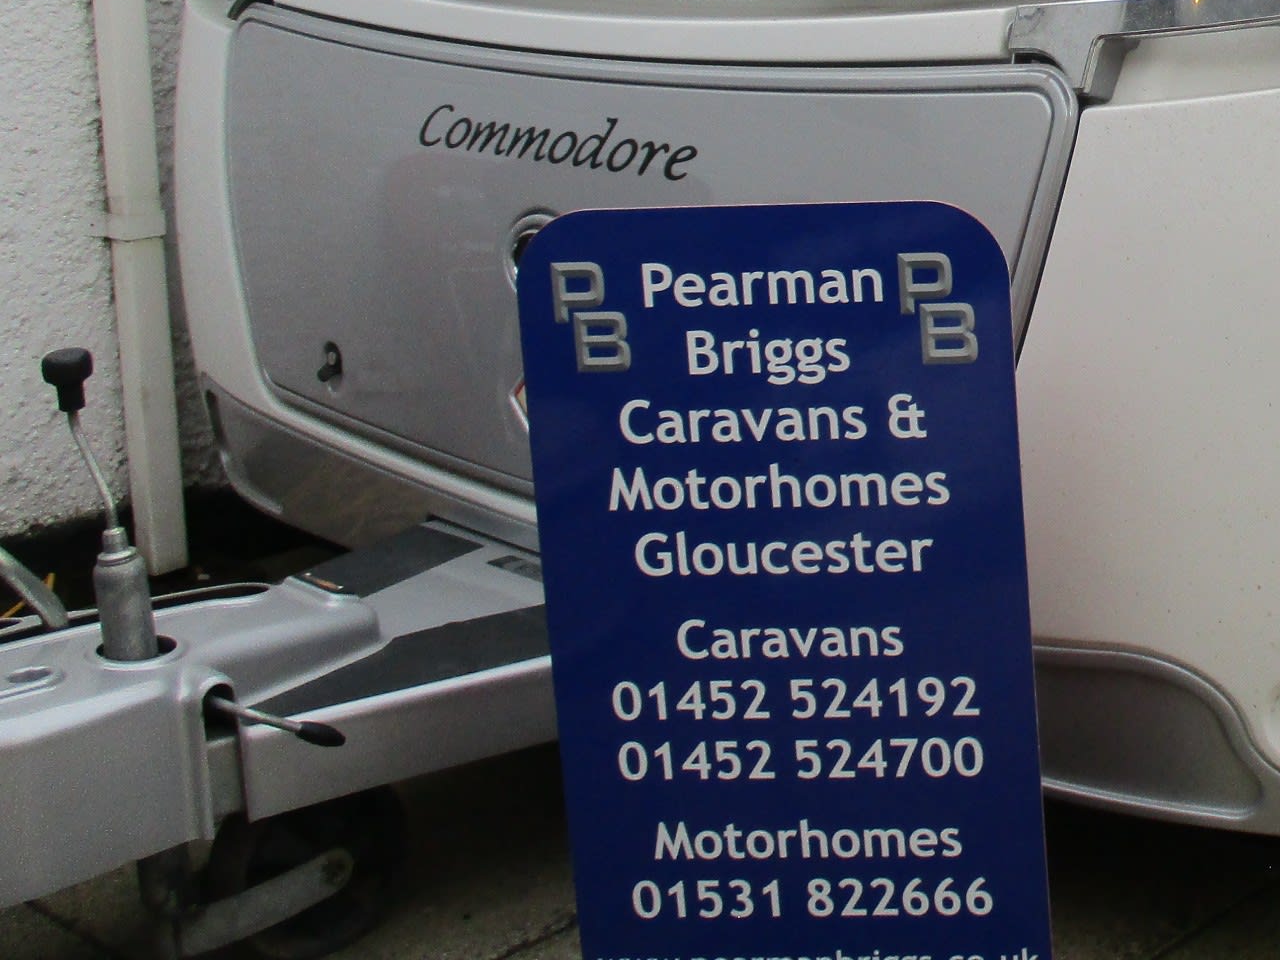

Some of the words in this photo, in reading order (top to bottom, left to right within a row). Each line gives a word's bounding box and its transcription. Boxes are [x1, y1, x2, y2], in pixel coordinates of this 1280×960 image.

[418, 103, 699, 182] Commodore
[641, 262, 884, 309] Pearman
[685, 328, 851, 386] Briggs
[619, 399, 868, 445] Caravans
[887, 393, 928, 440] &
[608, 462, 951, 512] Motorhomes
[634, 530, 934, 577] Gloucester
[676, 618, 905, 660] Caravans
[611, 679, 771, 722] 01452
[789, 676, 981, 720] 524192
[617, 739, 776, 781] 01452
[794, 736, 984, 780] 524700
[654, 818, 963, 861] Motorhomes
[631, 879, 782, 920] 01531
[807, 876, 994, 918] 822666
